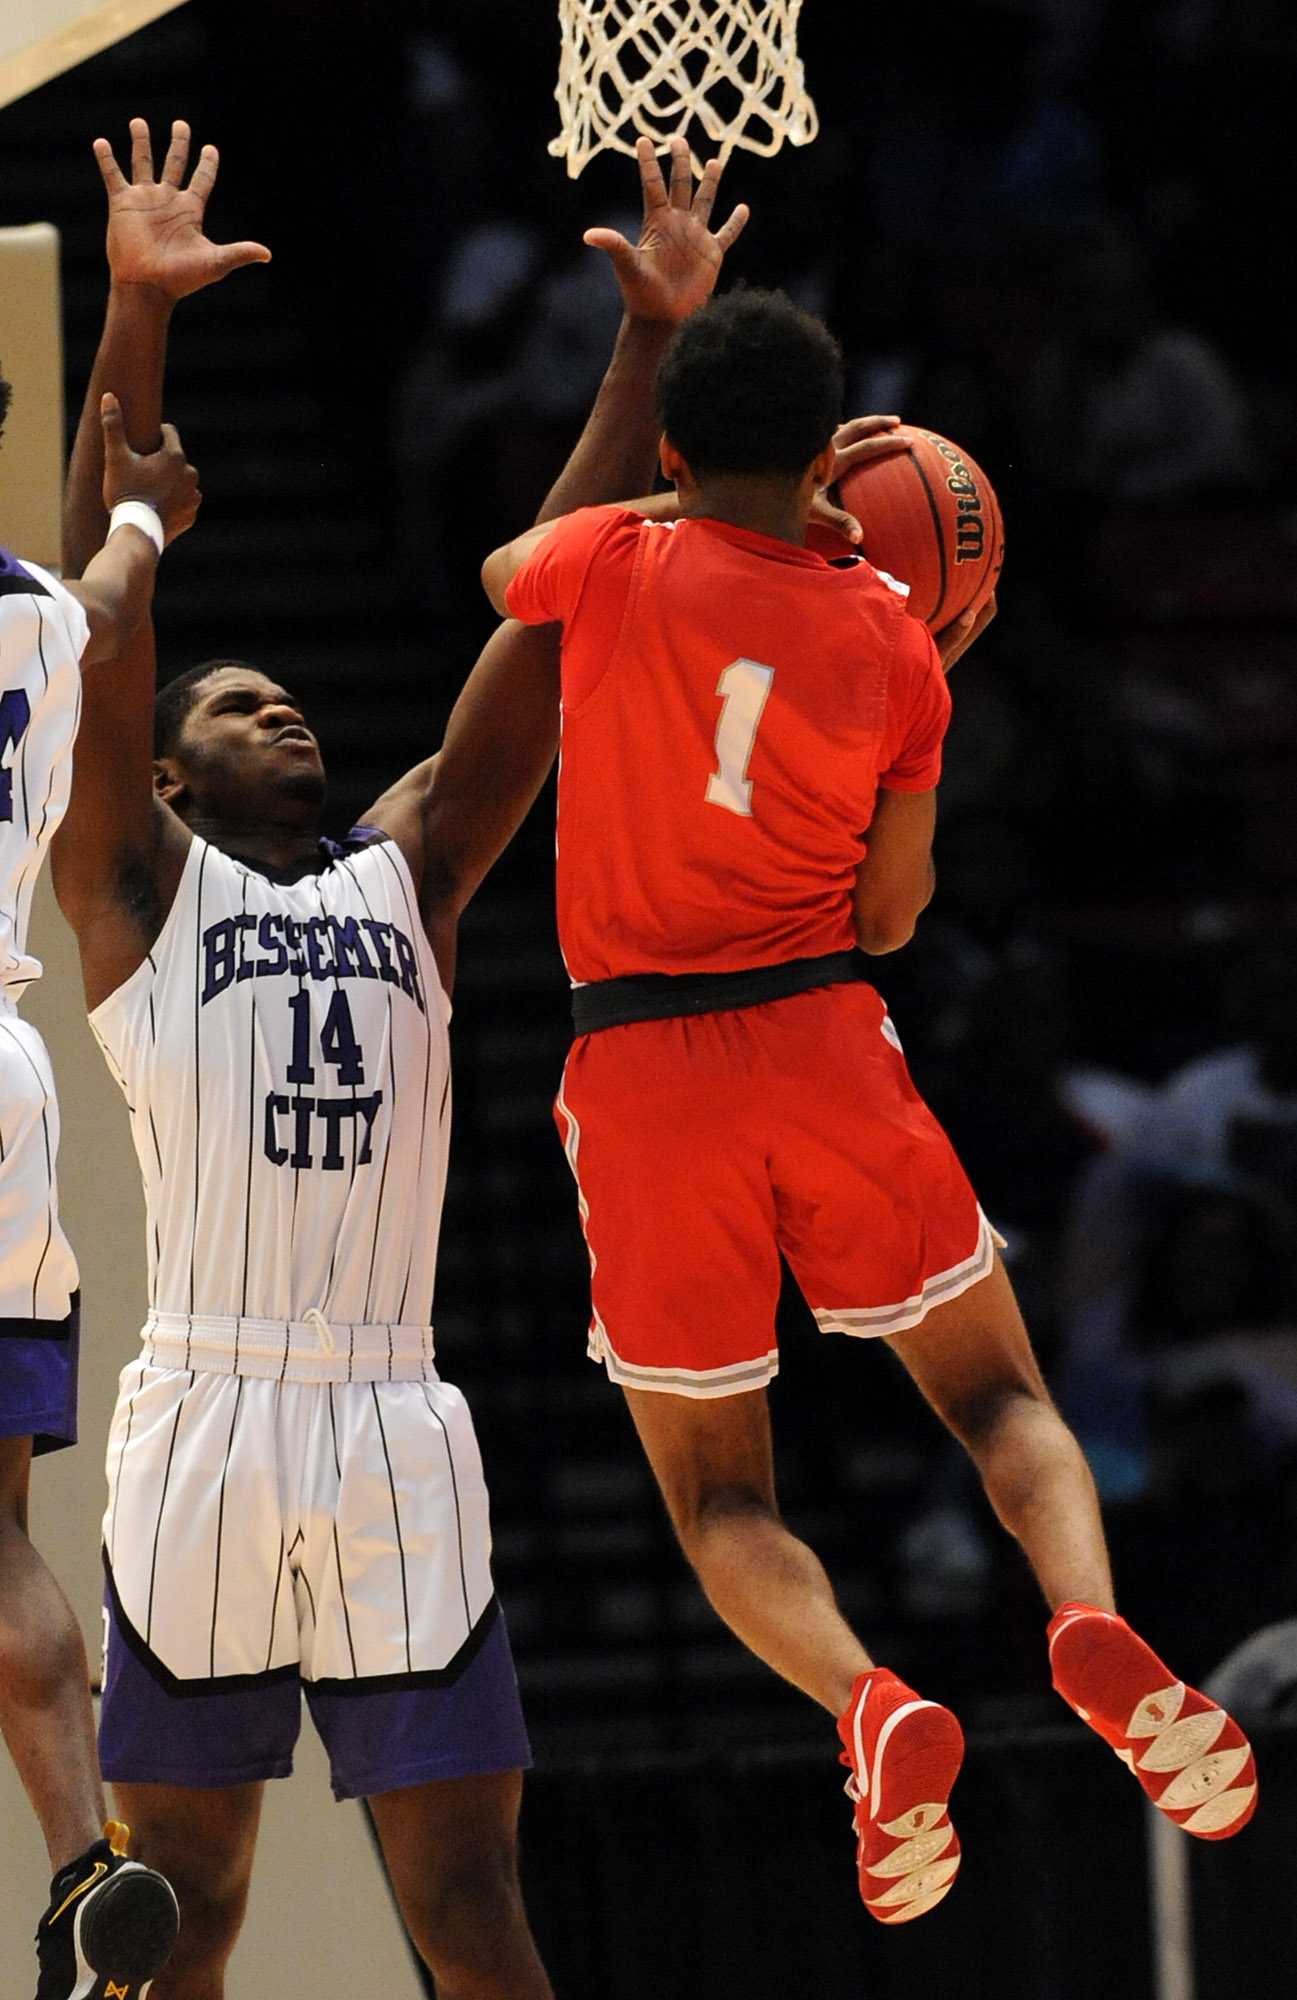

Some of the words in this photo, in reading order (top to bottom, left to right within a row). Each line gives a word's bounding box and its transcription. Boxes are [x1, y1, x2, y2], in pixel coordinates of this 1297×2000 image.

[704, 657, 776, 817] 1
[286, 988, 365, 1085] 14
[264, 1090, 383, 1170] CITY
